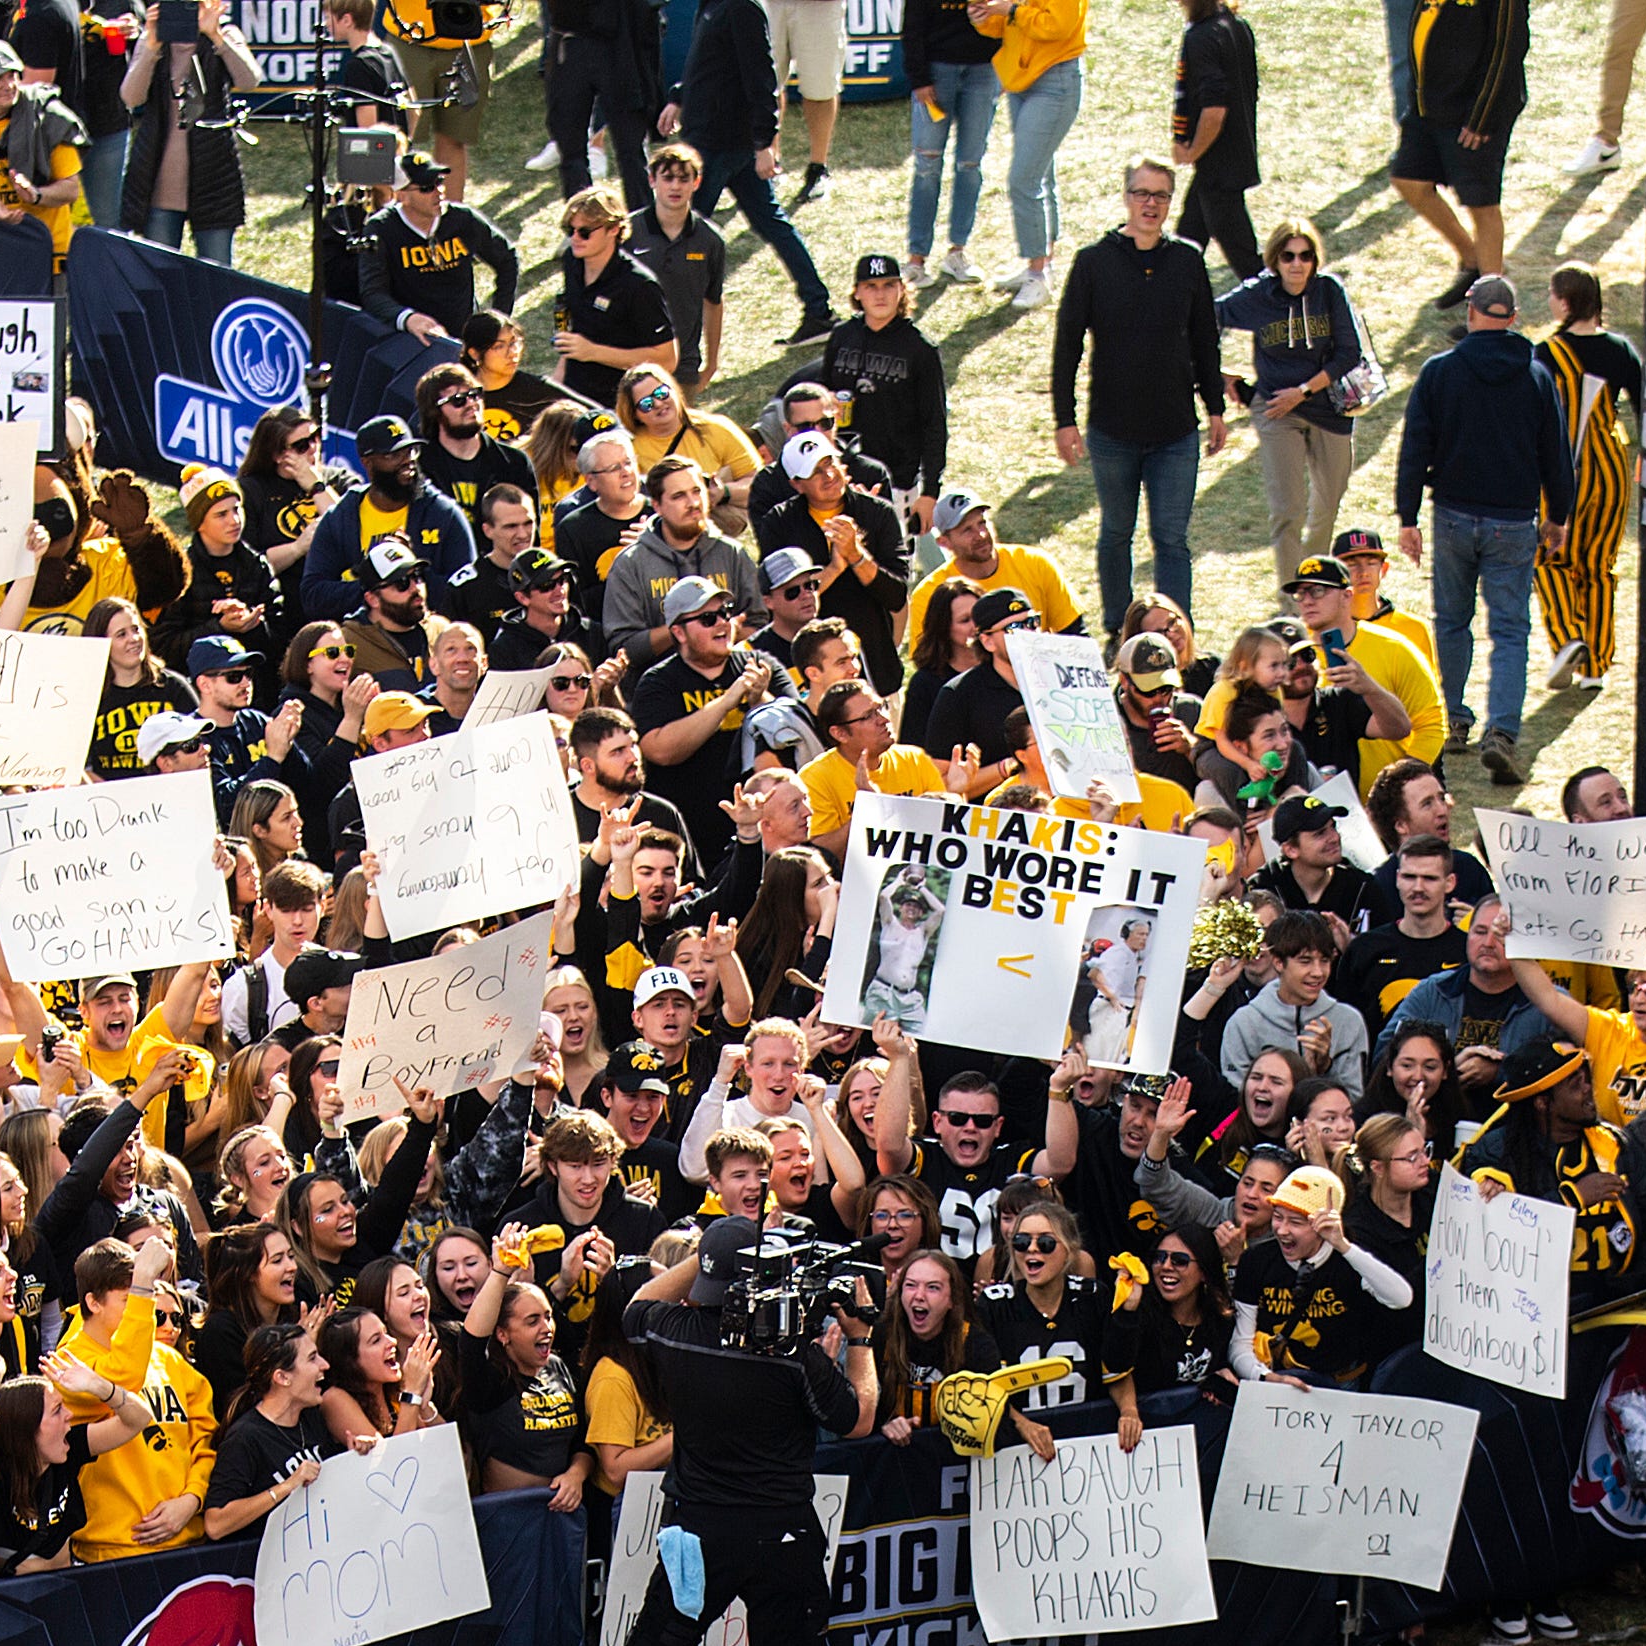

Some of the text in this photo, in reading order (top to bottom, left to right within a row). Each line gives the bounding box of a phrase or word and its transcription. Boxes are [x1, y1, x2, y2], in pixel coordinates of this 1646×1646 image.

[400, 237, 469, 269] IOWA
[32, 682, 69, 710] is
[1056, 661, 1110, 690] DEFENSE
[85, 798, 170, 838] Drunk
[865, 827, 1176, 907] WHO WORE IT
[1563, 832, 1606, 861] the
[17, 850, 147, 894] to make a
[962, 872, 1076, 926] BEST
[12, 906, 66, 942] good
[1567, 920, 1606, 944] Go
[373, 943, 509, 1023] Need
[1454, 1267, 1500, 1313] them
[1265, 1405, 1445, 1450] TORY TAYLOR
[1320, 1440, 1345, 1487] 4
[282, 1494, 330, 1562] Hi
[994, 1502, 1162, 1572] POOPS HIS
[839, 1527, 940, 1613] BIG
[1033, 1567, 1158, 1624] KHAKIS
